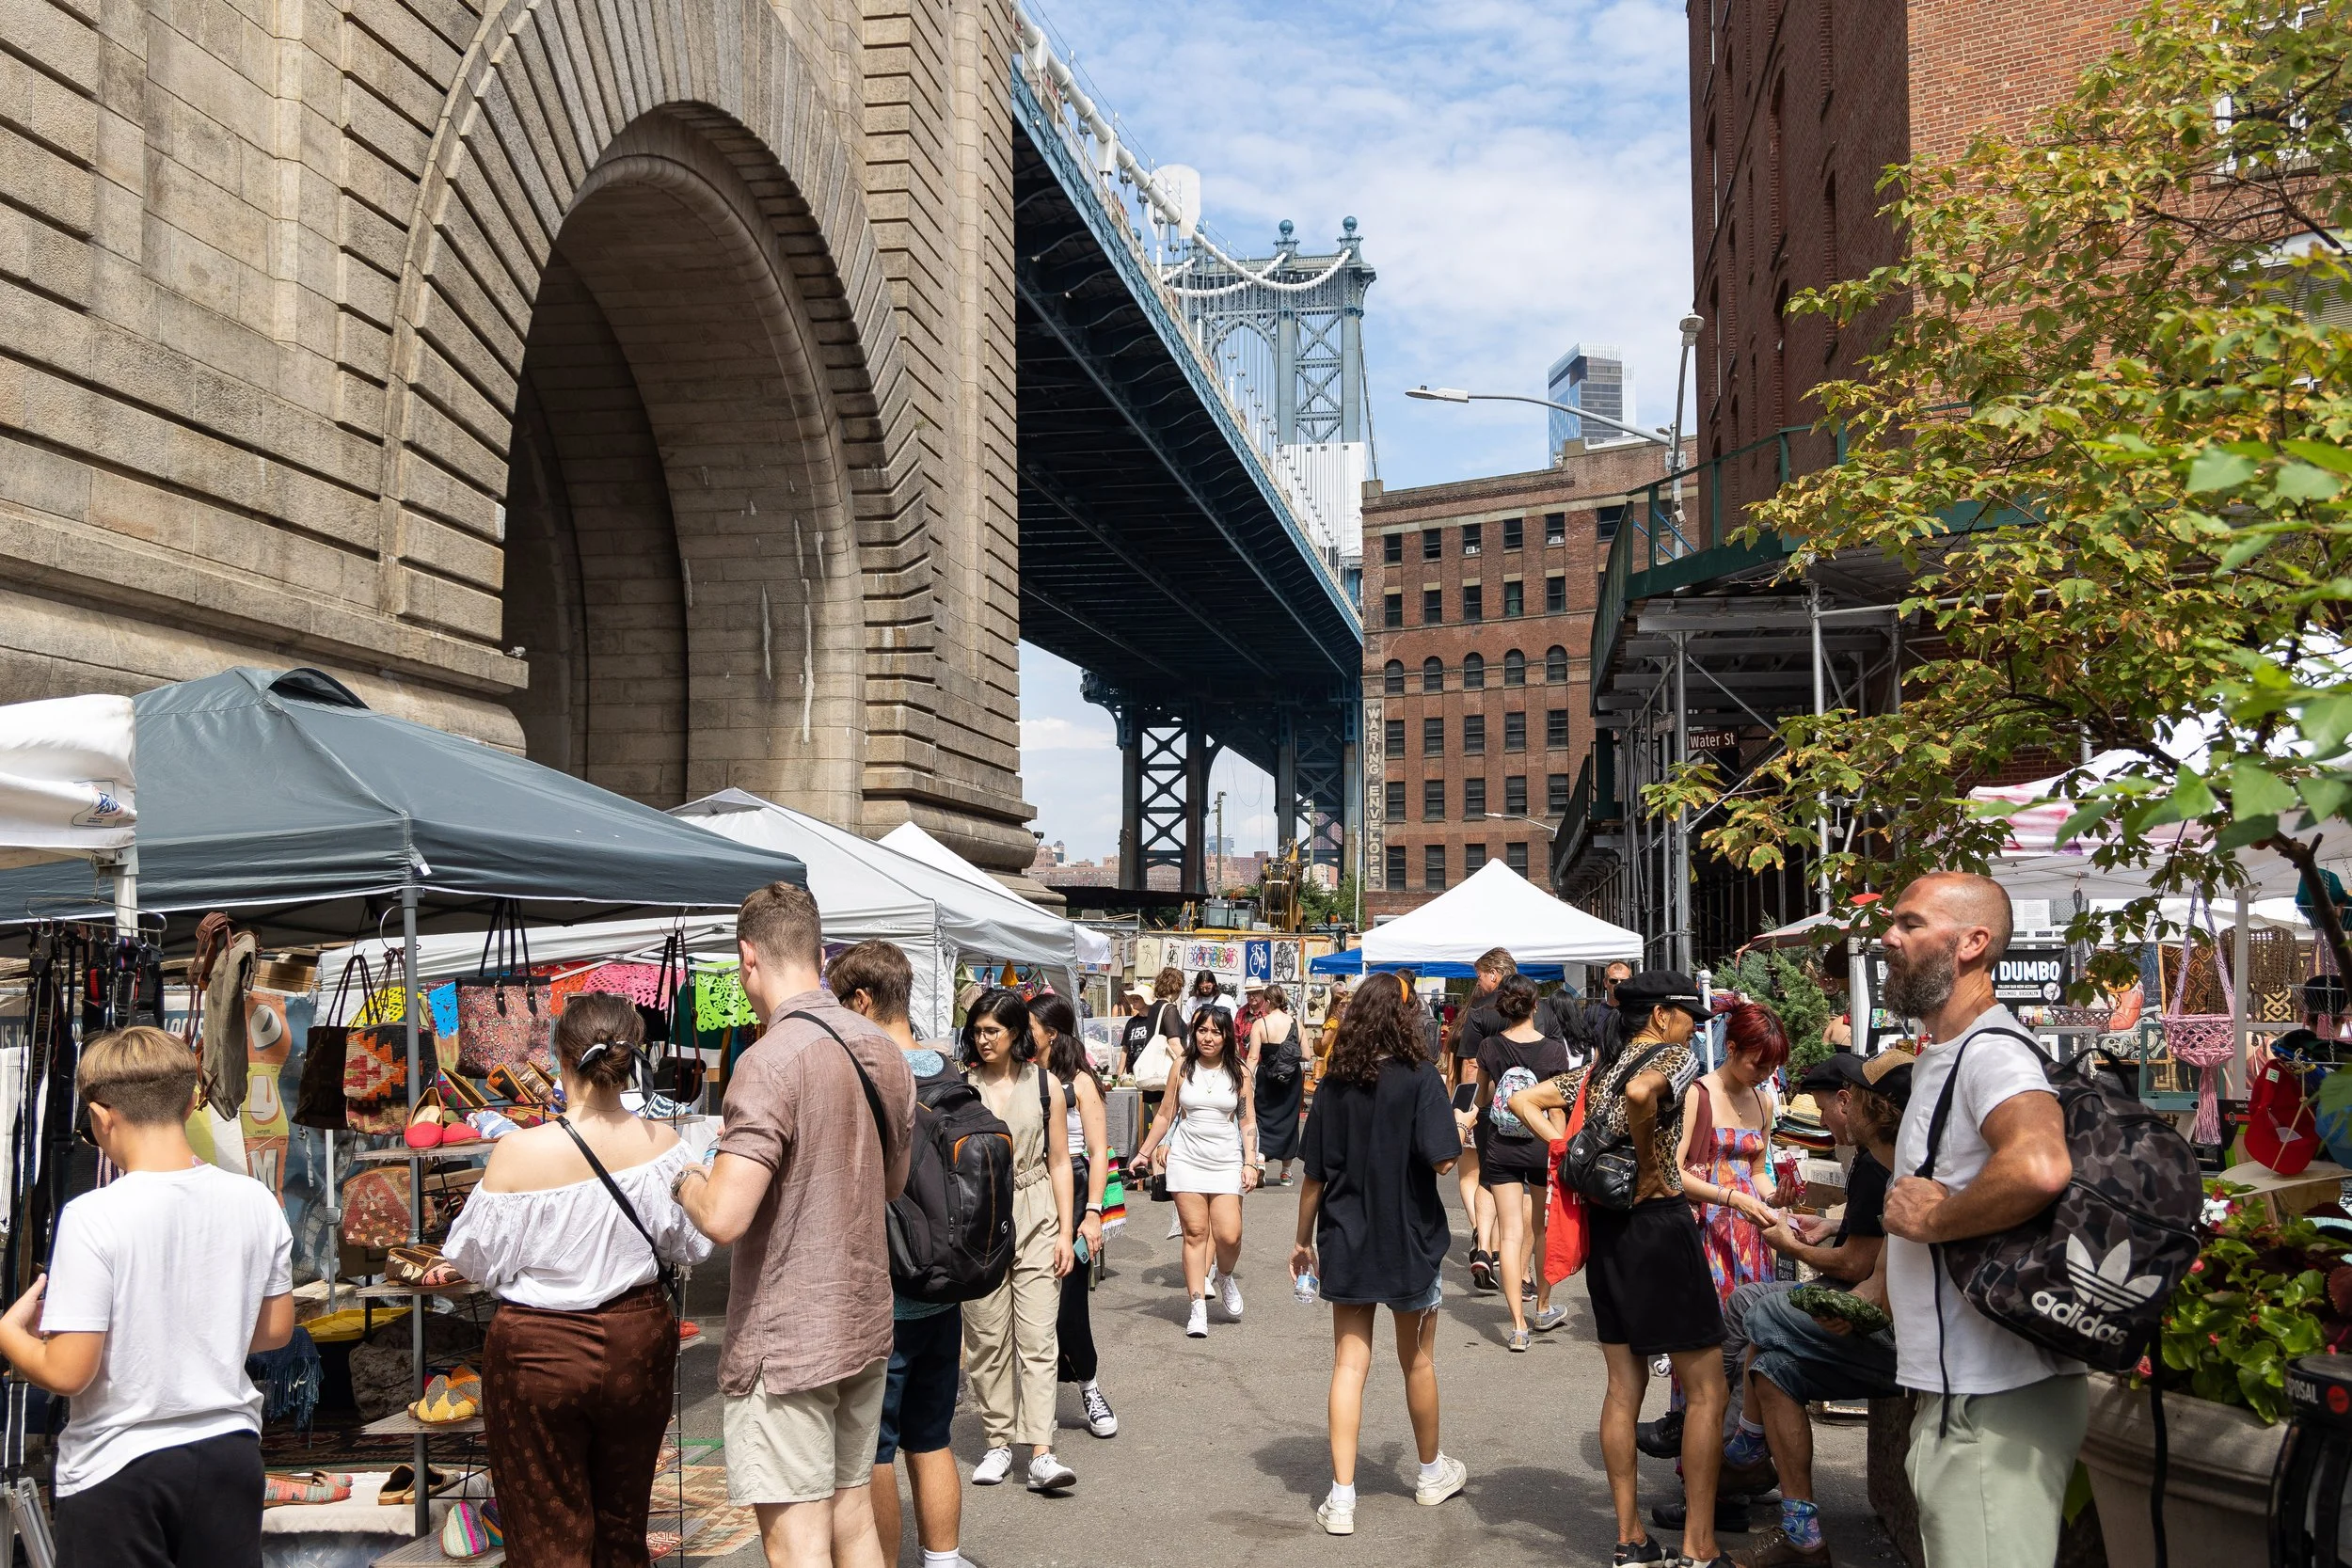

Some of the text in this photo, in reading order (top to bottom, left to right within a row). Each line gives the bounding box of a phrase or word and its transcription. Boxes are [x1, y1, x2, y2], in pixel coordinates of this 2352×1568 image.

[1690, 732, 1735, 749] Water St
[1367, 708, 1382, 878] WARING ENVELOPE
[1999, 960, 2060, 981] DUMBO
[36, 1006, 51, 1033] ERIK
[2031, 1291, 2130, 1346] adidas
